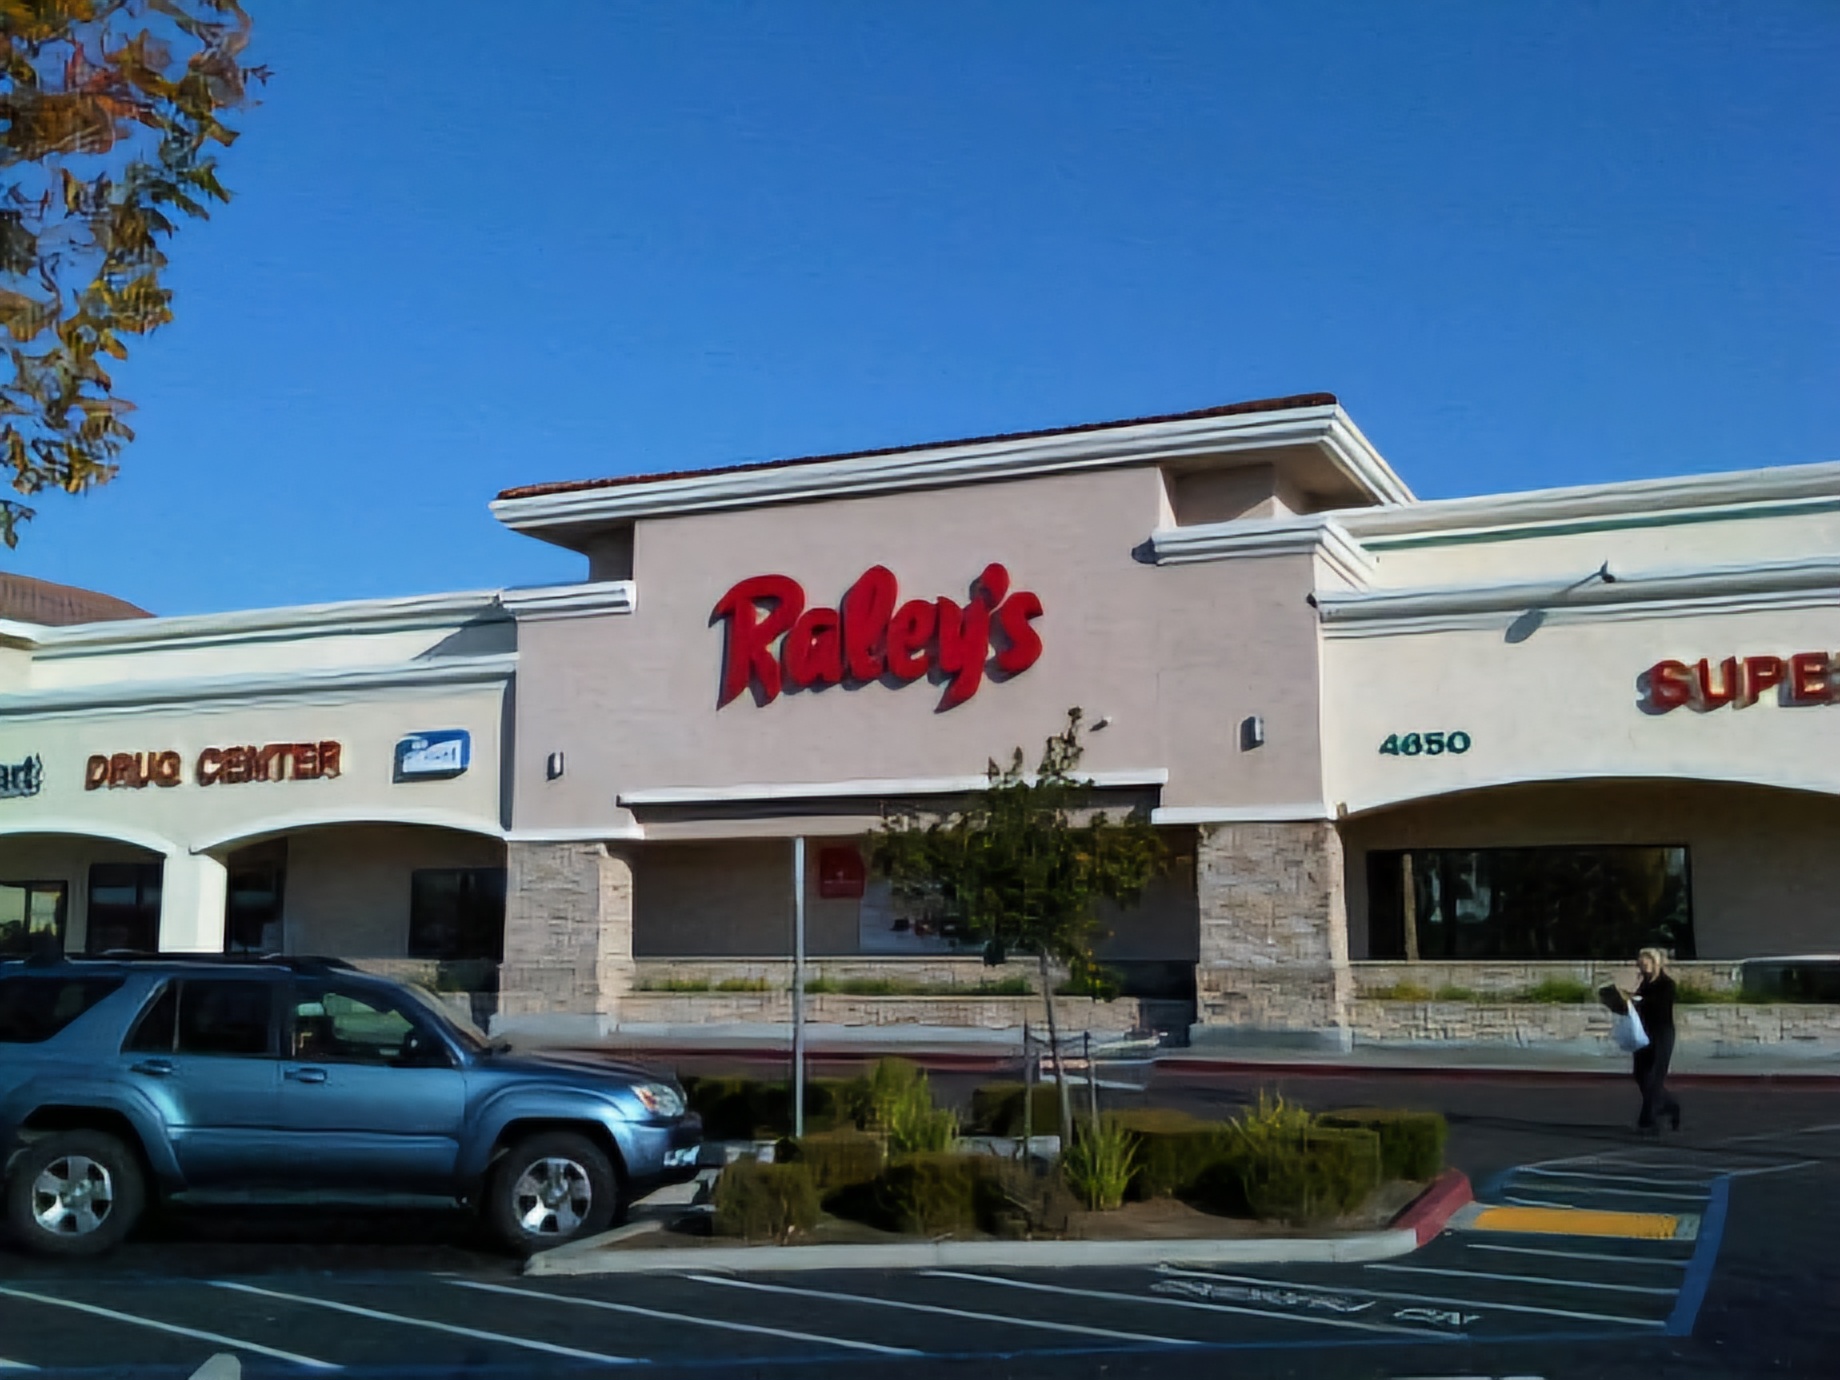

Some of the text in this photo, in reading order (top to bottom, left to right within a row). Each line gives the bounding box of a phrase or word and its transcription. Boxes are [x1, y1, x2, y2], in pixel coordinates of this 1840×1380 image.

[709, 562, 1043, 714] Raley's
[1643, 651, 1840, 710] SUPE
[198, 740, 342, 787] CENTER
